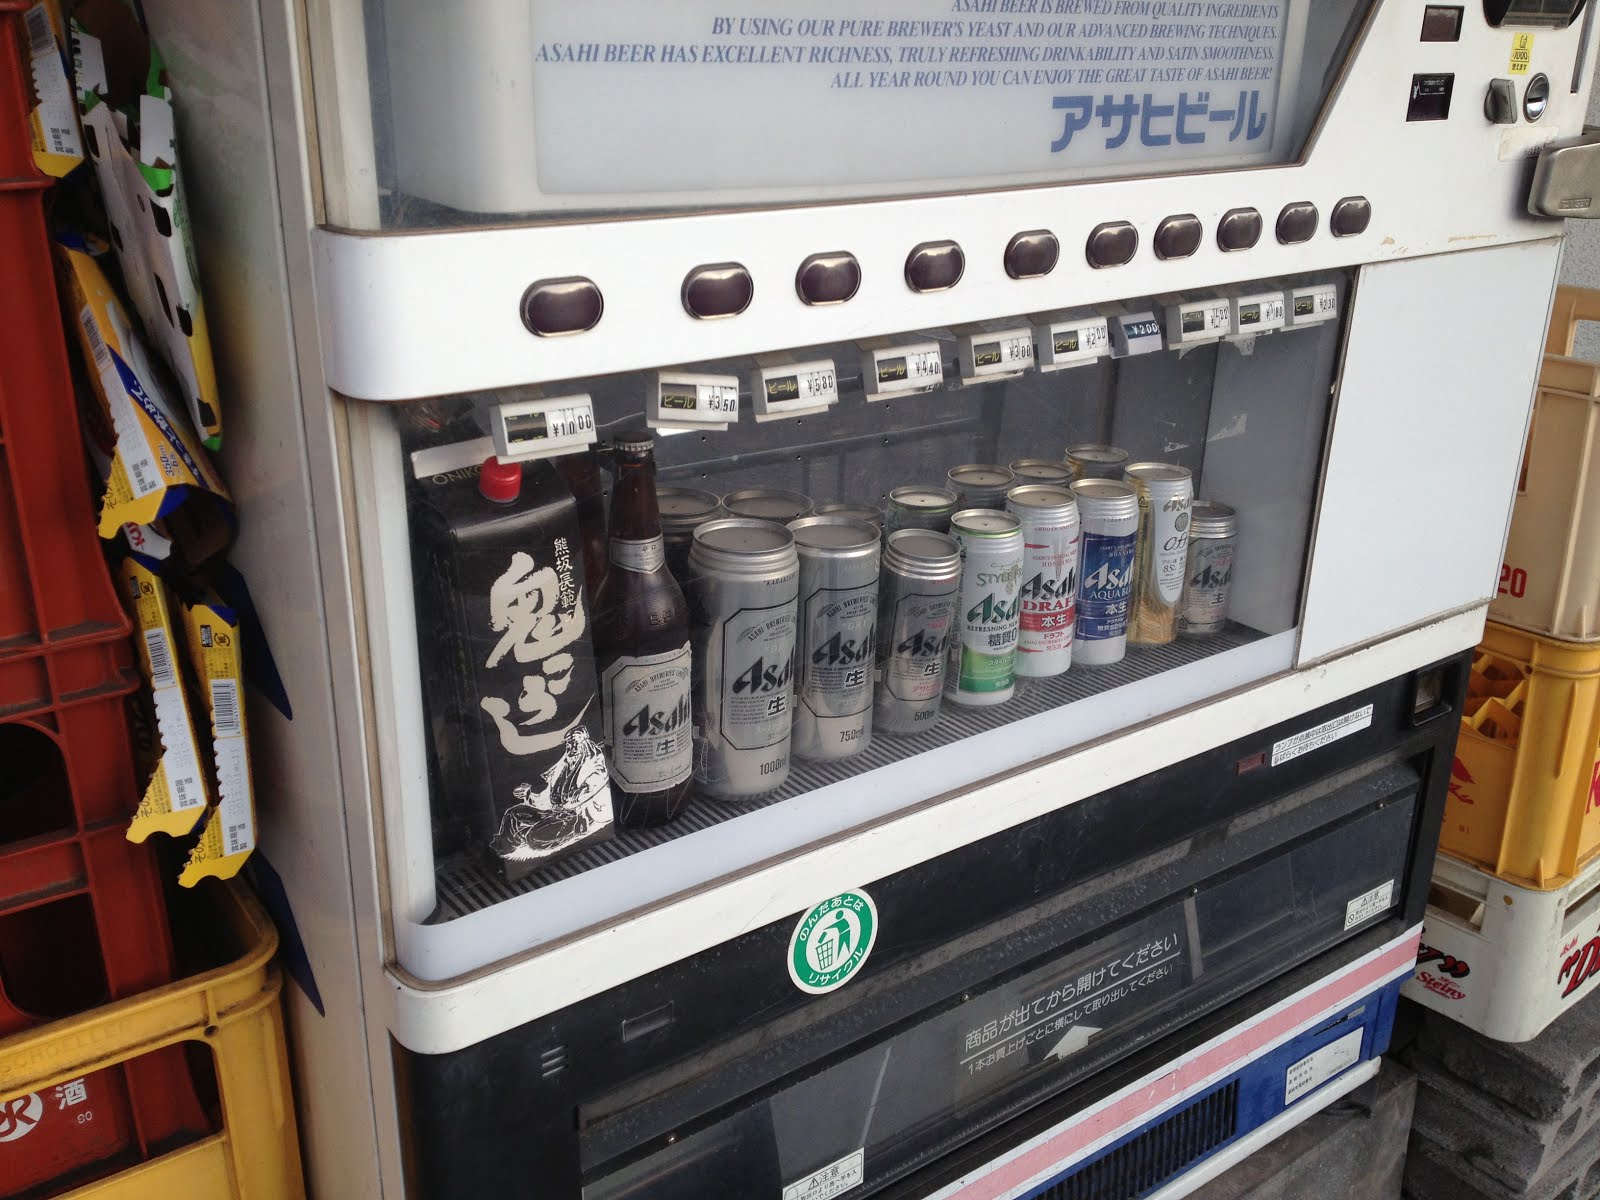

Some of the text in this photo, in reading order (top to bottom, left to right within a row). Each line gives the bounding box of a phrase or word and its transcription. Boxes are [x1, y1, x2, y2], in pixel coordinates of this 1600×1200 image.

[952, 0, 1279, 19] ASAHI BEER IS BREWED FROM QUALITY INGREDIENTS
[712, 17, 1277, 42] BY USING OUR PURE BREWER'S YEAST AND OUR ADVANCED BREWING TECHNIQUES.
[535, 43, 600, 62] ASAHI
[604, 43, 656, 63] BEER
[660, 44, 699, 63] HAS
[701, 45, 806, 63] EXCELLENT
[808, 45, 893, 66] RICHNESS,
[898, 46, 947, 63] TRULY
[949, 46, 1040, 63] REFRESHING
[1042, 46, 1136, 62] DRINKABILITY
[1137, 46, 1165, 61] AND
[1166, 46, 1200, 61] SATIN
[830, 66, 1273, 89] ALL YEAR ROUND YOU CAN ENJOY THE GREAT TASTE OF ASAHI BEER!
[1050, 90, 1267, 153] アサヒビール
[1132, 322, 1158, 335] ¥200
[1009, 344, 1031, 359] ¥300
[1055, 338, 1077, 351] ビール
[976, 351, 1000, 364] ビール
[879, 365, 905, 378] ビール
[915, 361, 940, 377] ¥440
[767, 382, 796, 394] ビール
[807, 375, 834, 393] ¥580
[664, 395, 694, 408] ビール
[708, 394, 736, 412] ¥350
[1090, 590, 1121, 600] AQUA
[1105, 601, 1127, 615] 本生
[1041, 613, 1067, 628] 本生
[1044, 631, 1064, 640] ドラフト
[924, 662, 940, 677] 生
[845, 670, 864, 687] 生
[767, 695, 786, 716] 生
[656, 739, 676, 756] 生
[800, 895, 864, 941] のんだあとは
[808, 947, 864, 986] リサイクル
[965, 933, 1178, 1053] 商品が出てから開けてください
[55, 1078, 88, 1110] 酒
[820, 1166, 839, 1184] 注意
